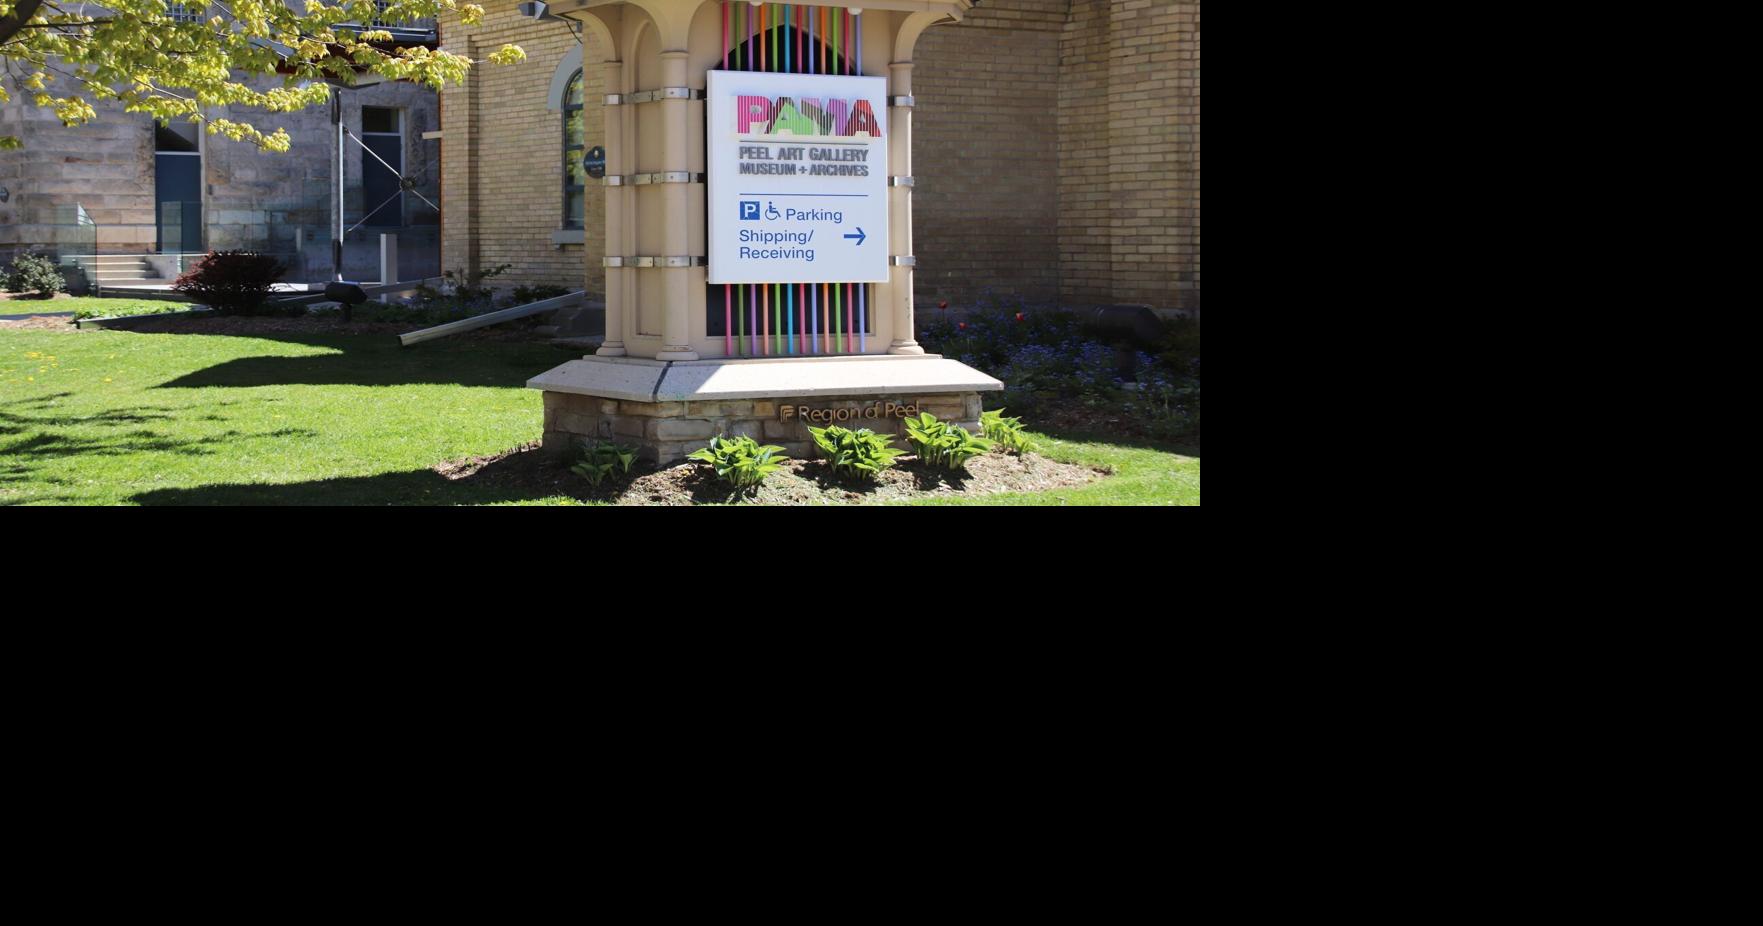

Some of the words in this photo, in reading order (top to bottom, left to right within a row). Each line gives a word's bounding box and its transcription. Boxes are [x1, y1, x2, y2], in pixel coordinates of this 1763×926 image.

[737, 95, 882, 137] PAMA
[739, 146, 774, 160] PEEL
[777, 147, 805, 161] ART
[809, 148, 869, 162] GALLERY
[739, 163, 797, 175] MUSEUM
[809, 164, 869, 177] ARCHIVES
[786, 208, 843, 224] Parking
[739, 229, 814, 245] Shipping/
[739, 246, 815, 261] Receiving
[799, 405, 861, 425] Region
[865, 401, 880, 419] of
[885, 400, 919, 418] Peel
